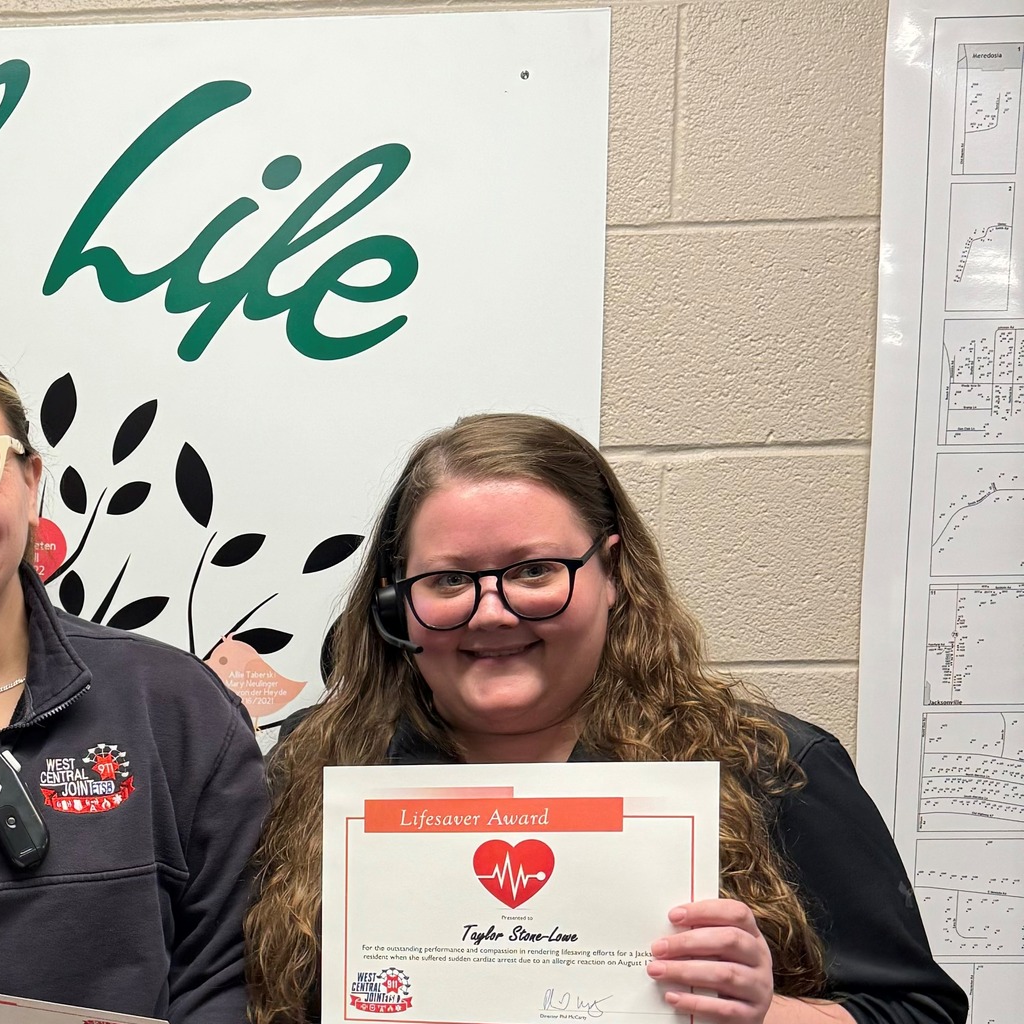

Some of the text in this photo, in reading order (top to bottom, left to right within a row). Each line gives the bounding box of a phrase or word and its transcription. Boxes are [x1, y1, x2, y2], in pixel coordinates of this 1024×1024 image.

[43, 79, 418, 362] Life
[264, 689, 287, 697] Heyde
[46, 758, 75, 771] WEST
[98, 763, 114, 774] 911
[40, 768, 88, 783] CENTRAL
[62, 780, 93, 796] JOINT
[400, 808, 549, 829] Lifesaver Award
[462, 924, 578, 945] Taylor Stone-Lowe
[424, 946, 464, 954] performance
[527, 948, 560, 957] rendering
[561, 949, 590, 958] lifesaving
[552, 958, 575, 966] allergic
[358, 972, 376, 982] WEST
[351, 982, 381, 992] CENTRAL
[387, 980, 398, 989] 911
[364, 993, 385, 1002] JOINT
